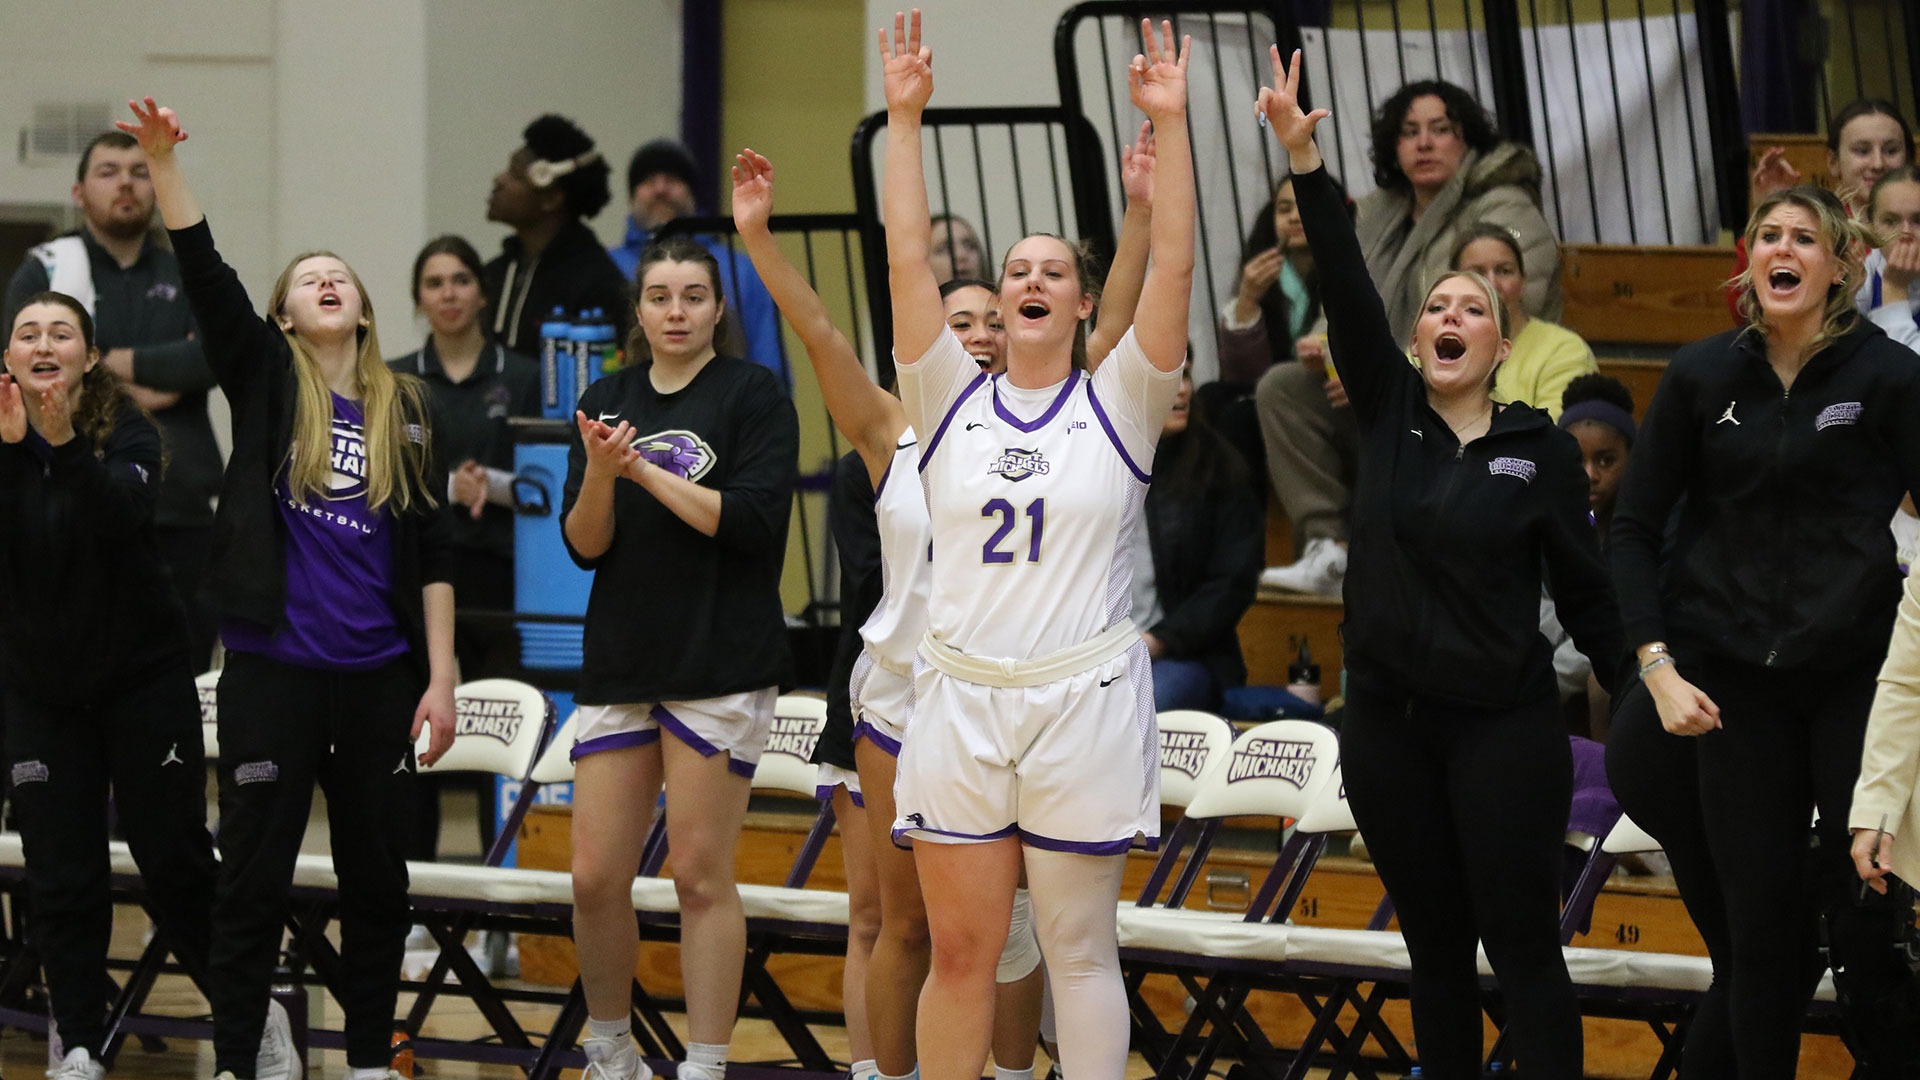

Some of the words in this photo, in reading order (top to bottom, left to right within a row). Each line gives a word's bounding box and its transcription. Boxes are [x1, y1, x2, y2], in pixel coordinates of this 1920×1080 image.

[274, 489, 377, 534] SKETBAL
[981, 497, 1047, 565] 21
[456, 698, 520, 717] SAINT
[456, 715, 521, 745] ICHAELS
[1160, 731, 1206, 749] AINT
[1160, 747, 1209, 780] HAELS
[1247, 740, 1314, 759] SAINT
[1229, 752, 1316, 789] MICHAELS
[1615, 923, 1639, 945] 49
